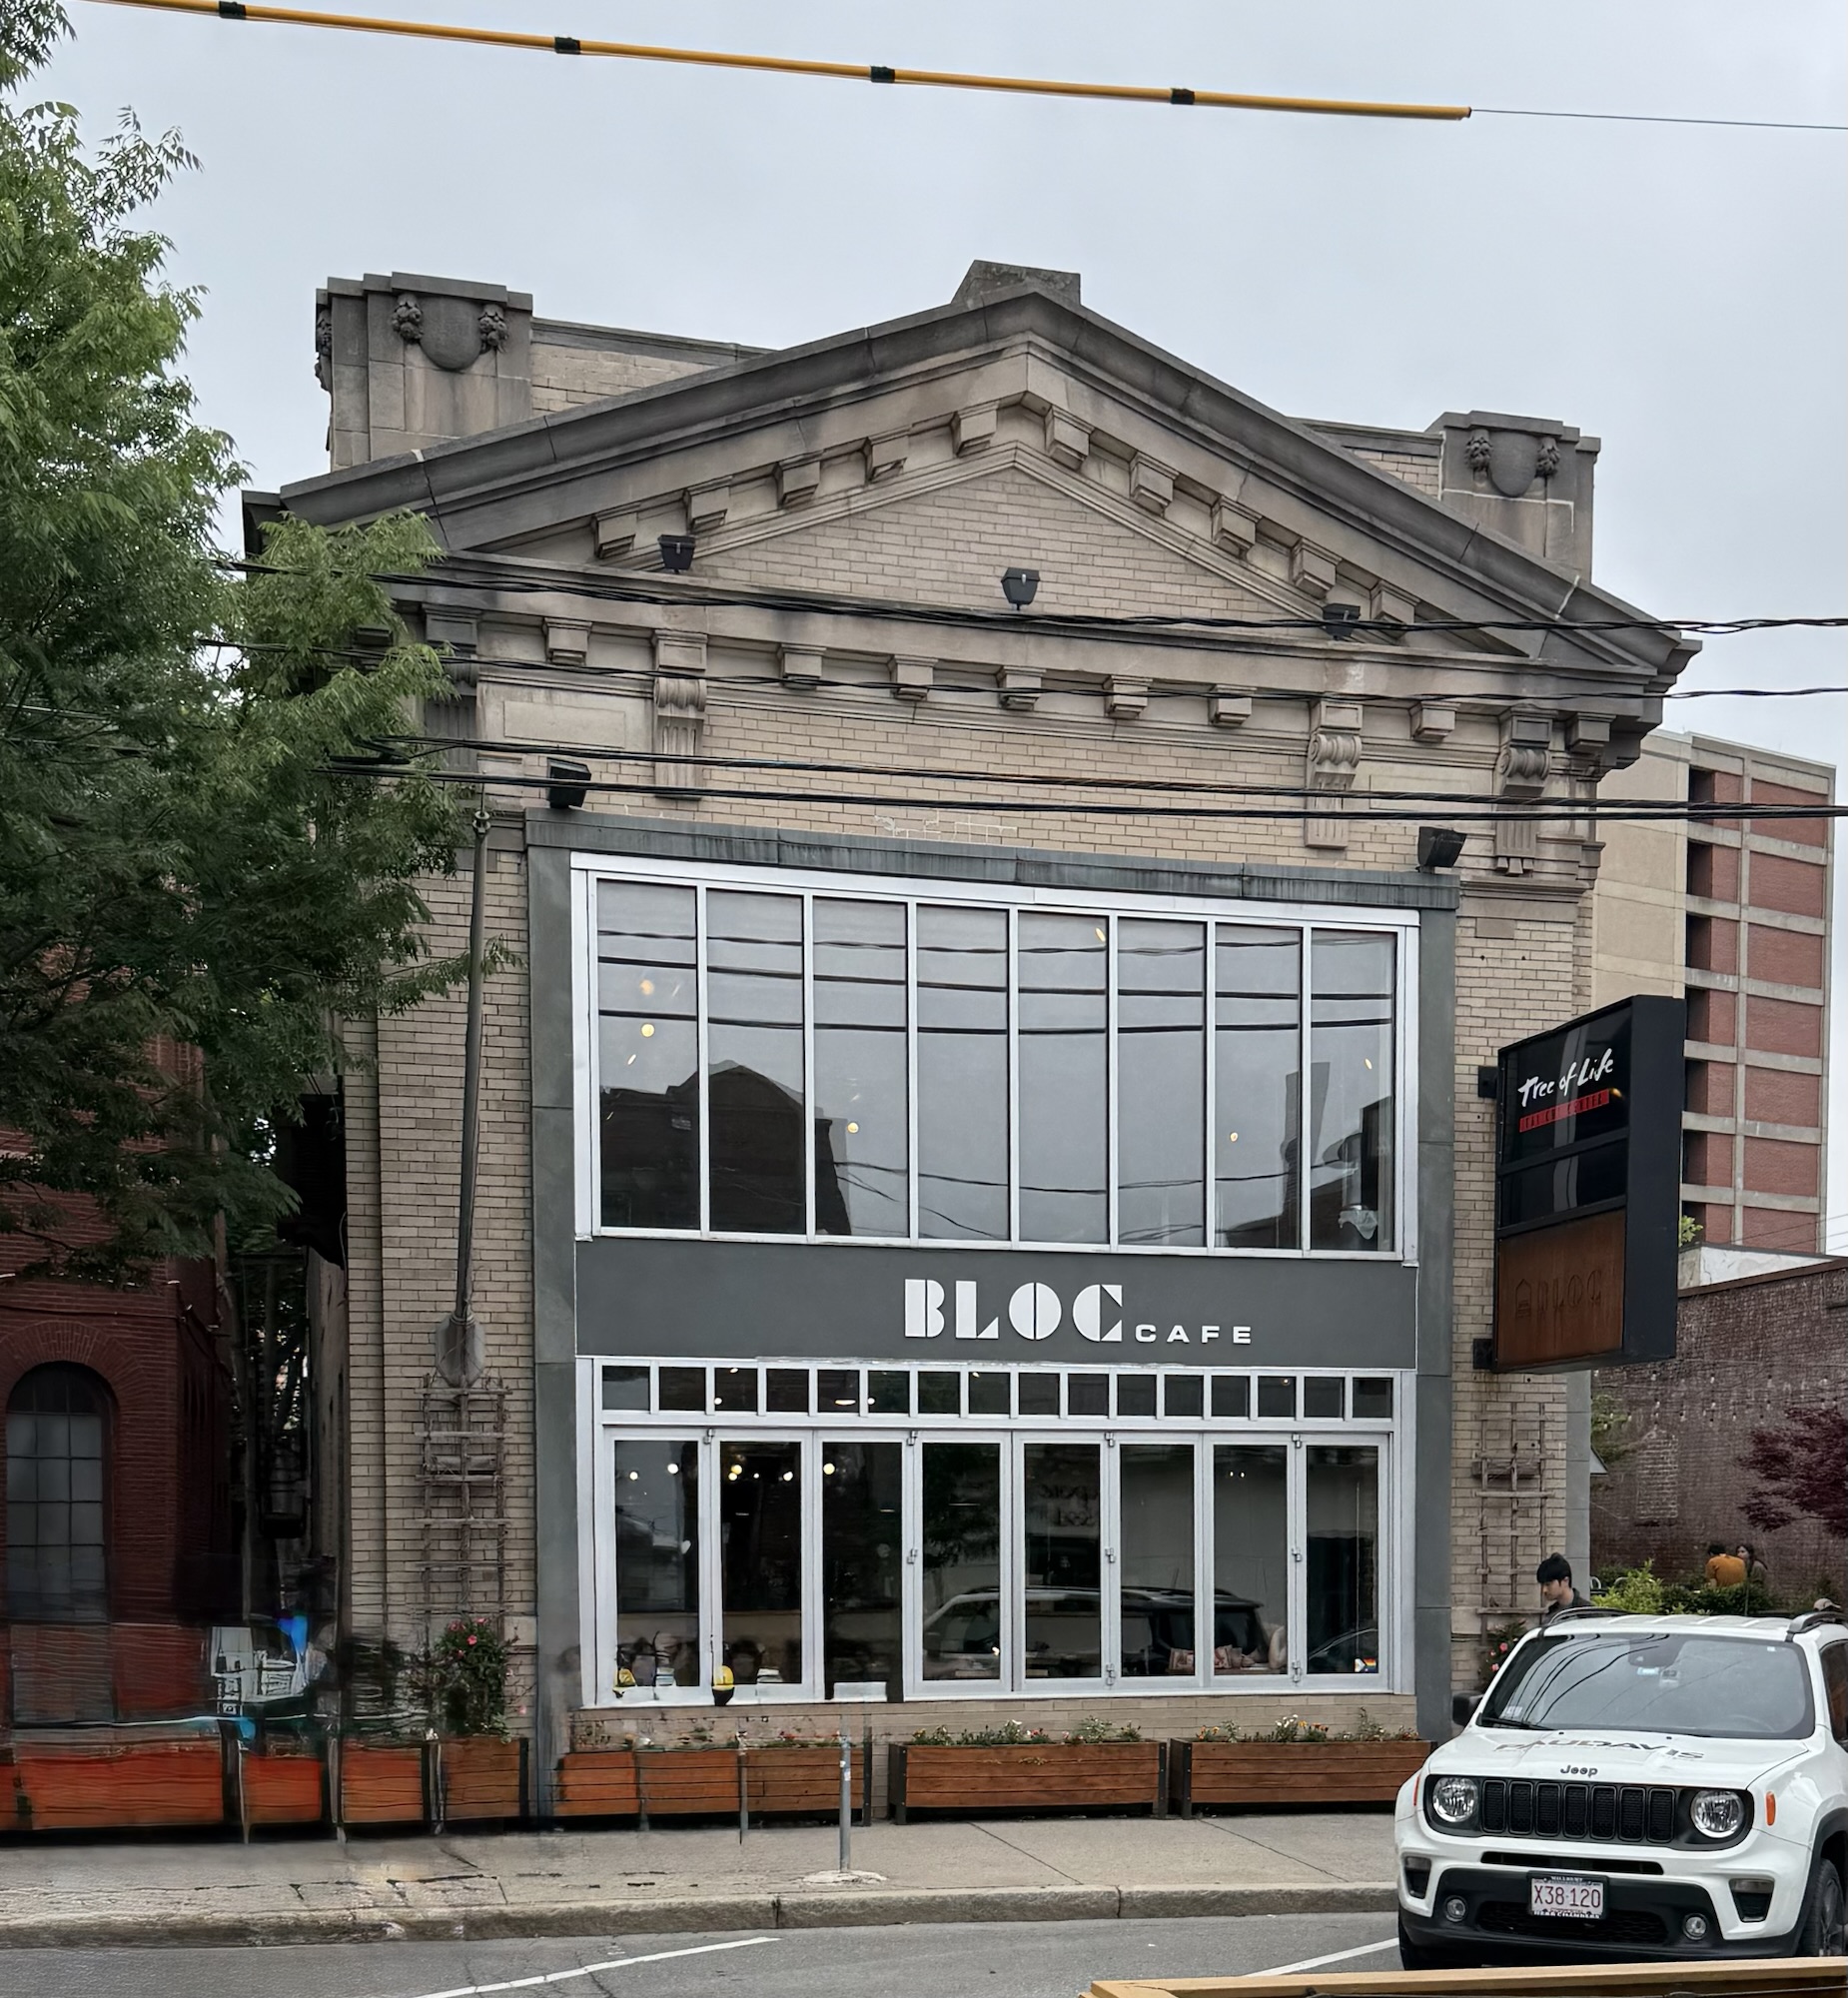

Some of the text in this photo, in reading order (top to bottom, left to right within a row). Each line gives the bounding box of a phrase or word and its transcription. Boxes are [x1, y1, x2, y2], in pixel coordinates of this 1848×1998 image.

[1517, 1048, 1613, 1108] Tree of Life
[904, 1279, 1252, 1345] BLOC CAFE
[1559, 1764, 1598, 1778] Jeep
